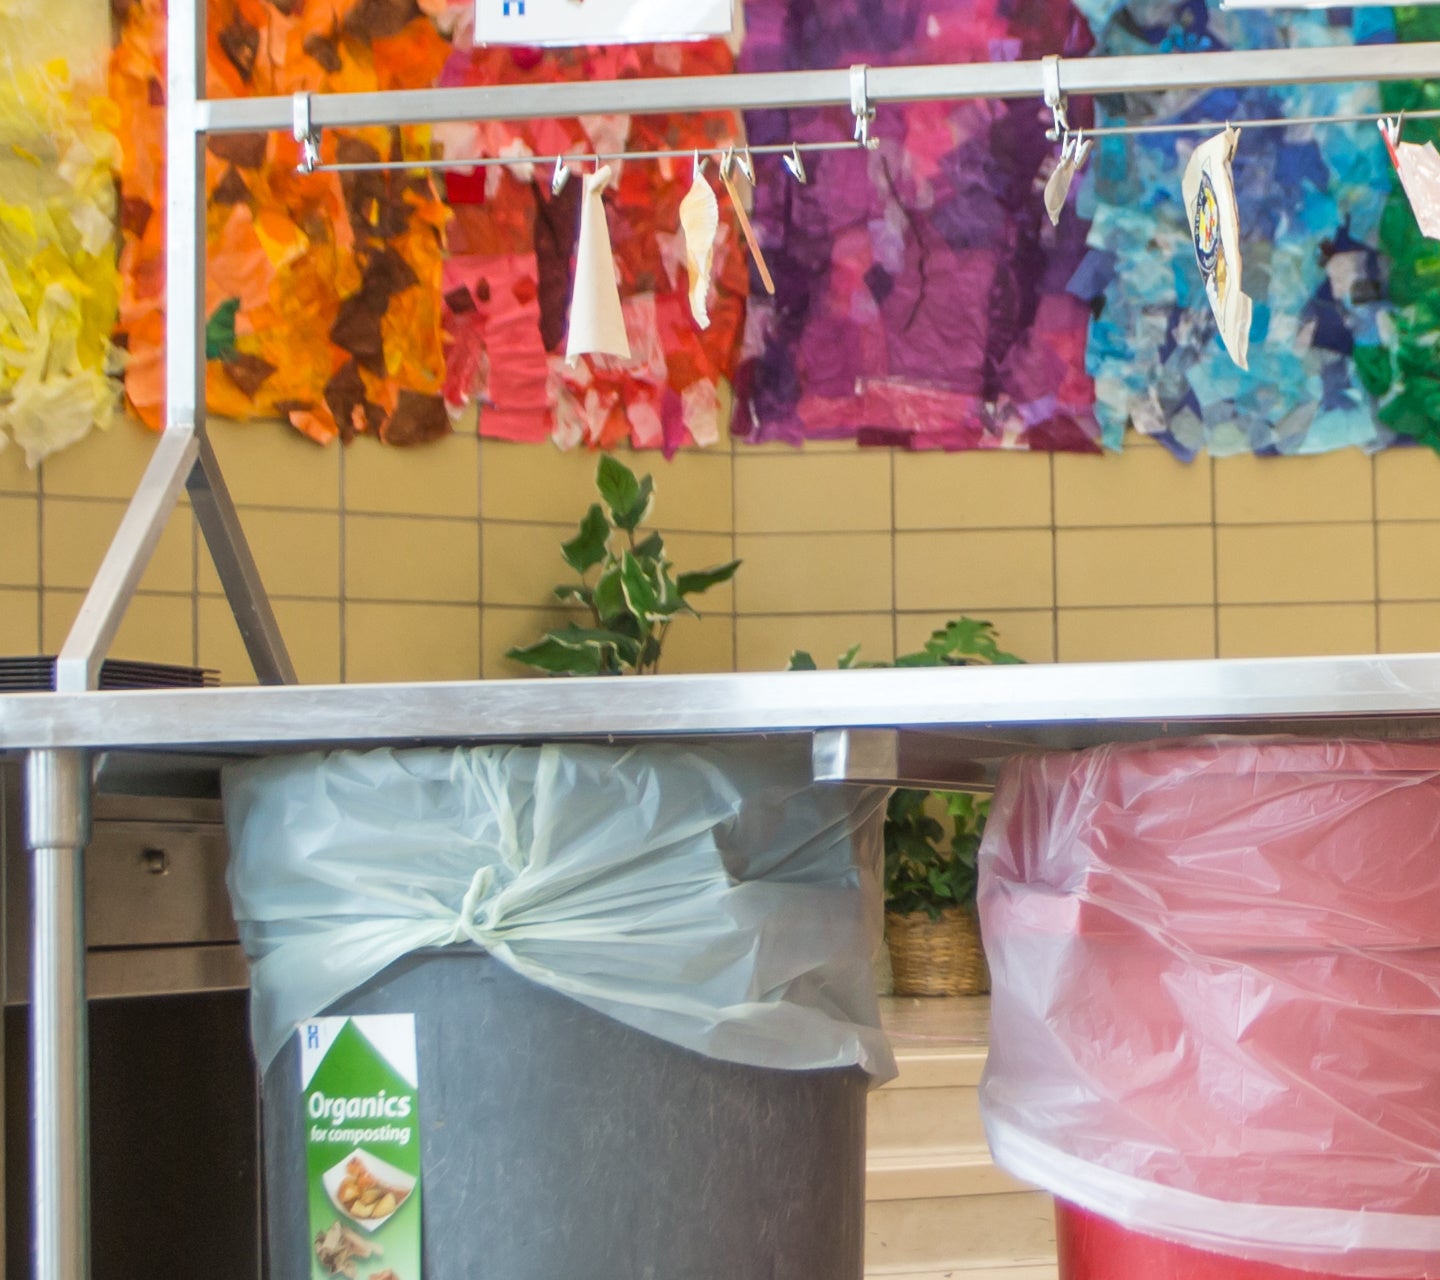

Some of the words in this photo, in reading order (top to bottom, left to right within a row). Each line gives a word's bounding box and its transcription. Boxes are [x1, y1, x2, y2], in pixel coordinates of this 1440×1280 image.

[308, 1089, 411, 1126] Organics
[311, 1124, 327, 1142] for
[328, 1124, 411, 1146] composting
